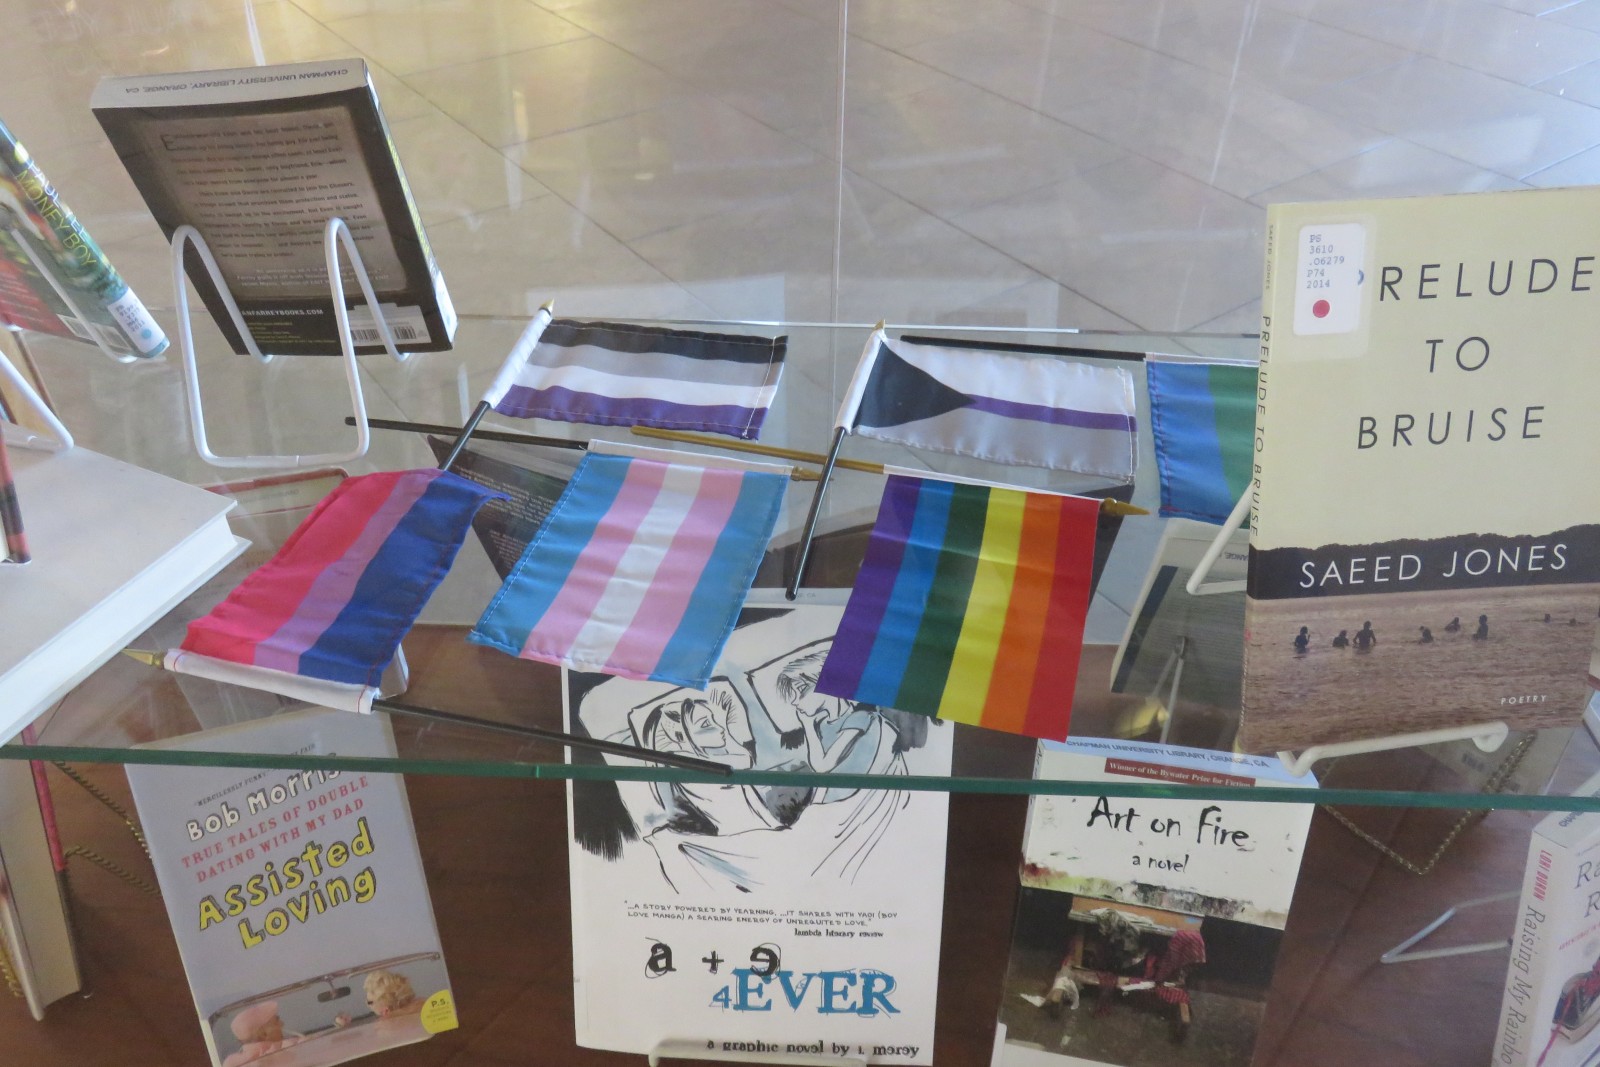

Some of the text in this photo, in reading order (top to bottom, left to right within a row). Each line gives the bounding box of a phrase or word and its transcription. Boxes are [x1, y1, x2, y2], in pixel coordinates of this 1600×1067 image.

[239, 75, 297, 85] UNIVERSITY
[299, 69, 348, 79] CHAPMAN
[16, 169, 71, 231] MONEY
[63, 232, 97, 265] BOY
[1309, 233, 1322, 243] PS
[1309, 244, 1333, 254] 3610
[1306, 268, 1325, 277] P74
[1306, 279, 1330, 289] 2014
[1358, 256, 1596, 302] RELUDE
[241, 308, 323, 316] ANFARREYBOOKS.COM
[1426, 336, 1490, 373] TO
[1250, 315, 1271, 537] PRELUDE TO BRUISE
[1357, 405, 1545, 449] BRUISE
[1299, 543, 1568, 589] SAEED JONES
[1500, 694, 1547, 705] POETRY
[1067, 739, 1111, 750] CHAPMAN
[1112, 744, 1164, 756] UNIVERSITY
[1253, 759, 1270, 768] CA
[1109, 762, 1136, 773] Winner
[1146, 767, 1159, 776] the
[1160, 768, 1190, 780] Bywater
[1191, 773, 1211, 783] Prize
[186, 752, 342, 842] Bob Morris
[181, 775, 369, 869] TRUE TALES OF DOUBLE
[1087, 796, 1141, 832] Art
[1150, 817, 1181, 838] on
[196, 798, 364, 883] DATING WITH MY DAD
[199, 816, 375, 931] Assisted
[1131, 854, 1189, 873] a novel
[238, 866, 377, 949] Loving
[643, 903, 671, 911] STORY
[675, 905, 716, 913] POWERED
[798, 910, 832, 918] SHARES
[652, 912, 685, 921] MANGA)
[697, 914, 733, 922] SEARING
[786, 918, 841, 926] UNREQUITED
[794, 927, 822, 937] lambda
[825, 928, 855, 938] literary
[1500, 905, 1547, 1065] Raising My Rainbo
[707, 1039, 715, 1049] a
[722, 1040, 778, 1054] graphic
[786, 1040, 824, 1054] novel
[832, 1042, 850, 1057] by
